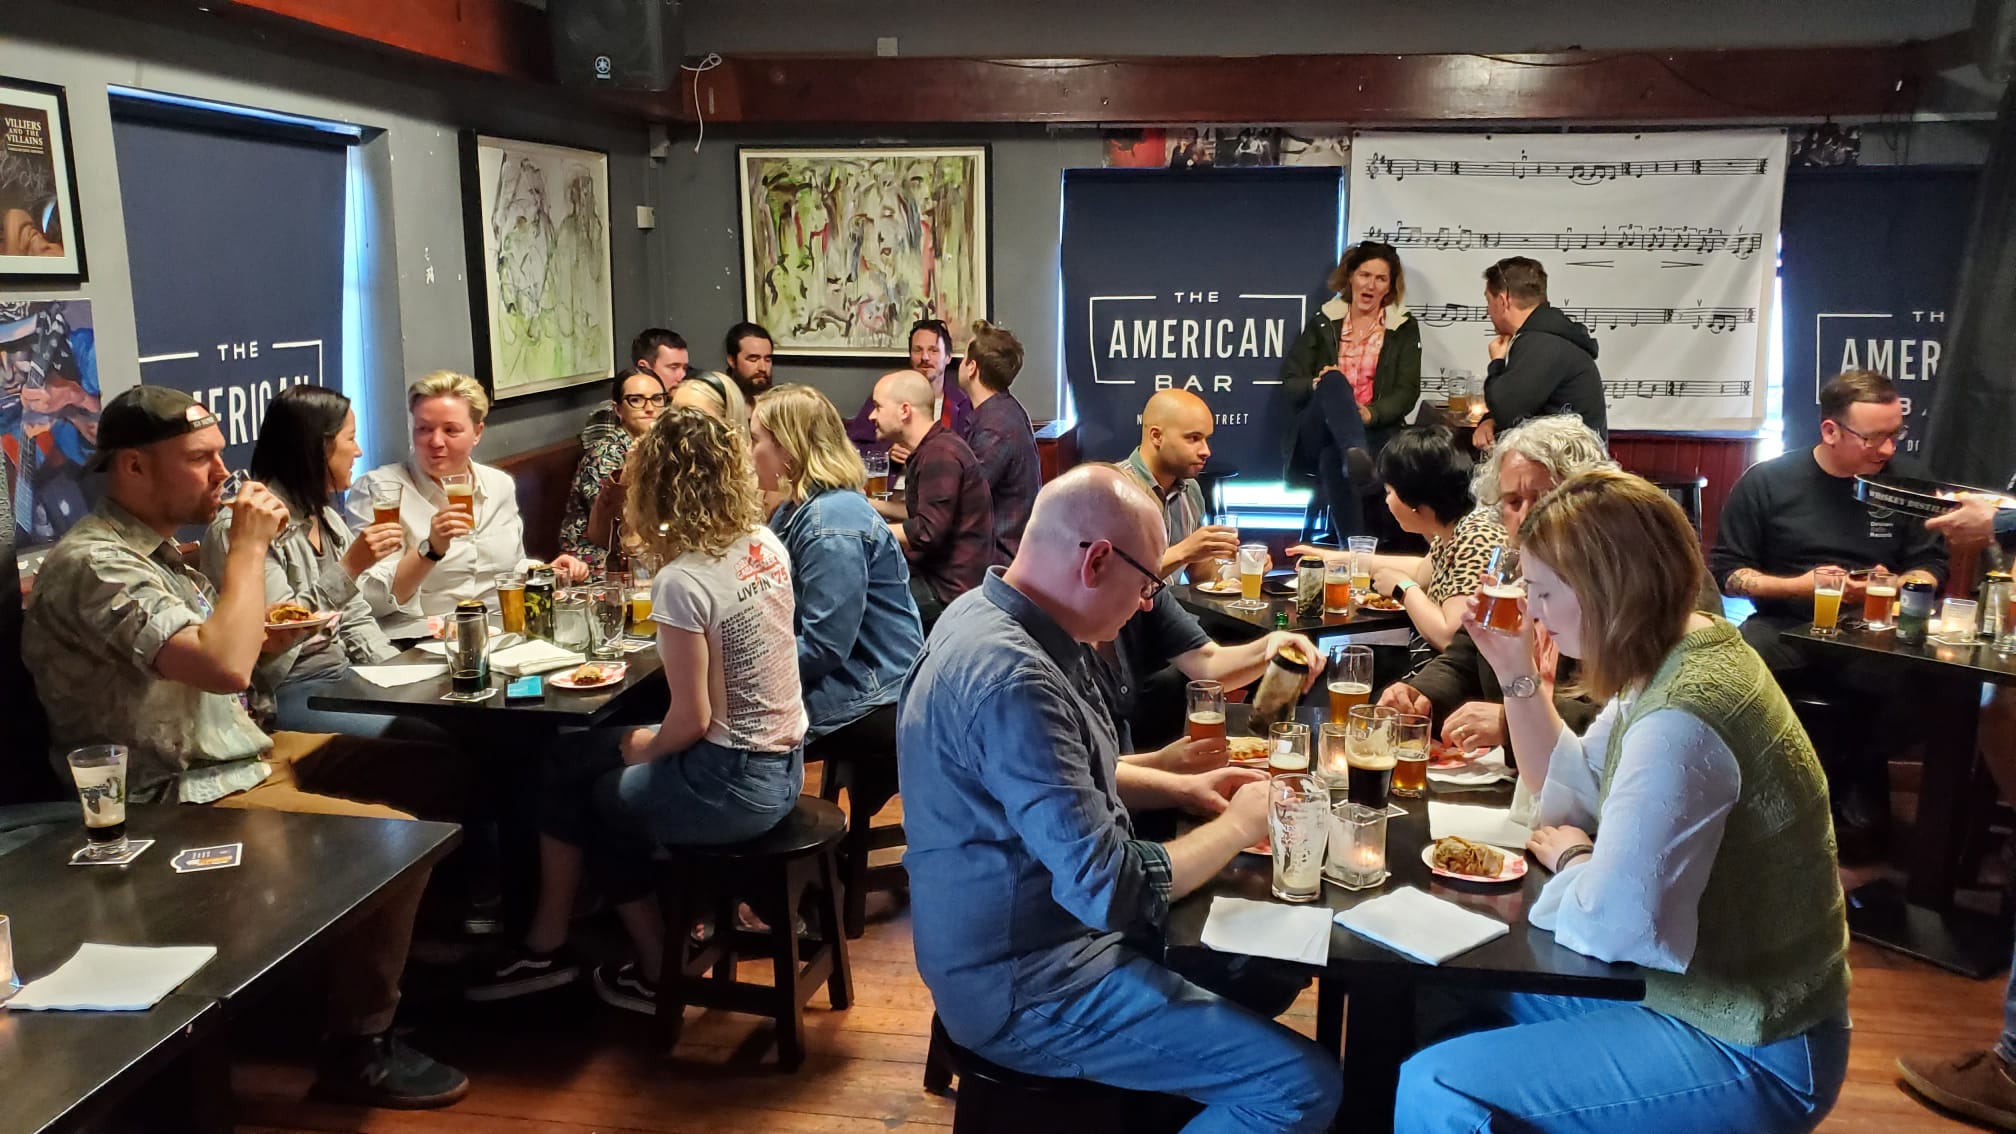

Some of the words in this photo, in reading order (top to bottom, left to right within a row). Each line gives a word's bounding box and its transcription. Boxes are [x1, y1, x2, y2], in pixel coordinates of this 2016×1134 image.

[5, 117, 41, 130] VILLIERS
[9, 127, 23, 135] AND
[7, 134, 43, 145] VILLAINS
[1174, 292, 1220, 303] THE
[1912, 311, 1945, 322] TH
[1108, 318, 1285, 359] AMERICAN
[217, 341, 258, 361] THE
[1840, 338, 1941, 381] AMER
[1155, 374, 1233, 392] BAR
[1215, 413, 1249, 425] TREET
[737, 582, 758, 602] LIVE
[760, 576, 771, 591] IN
